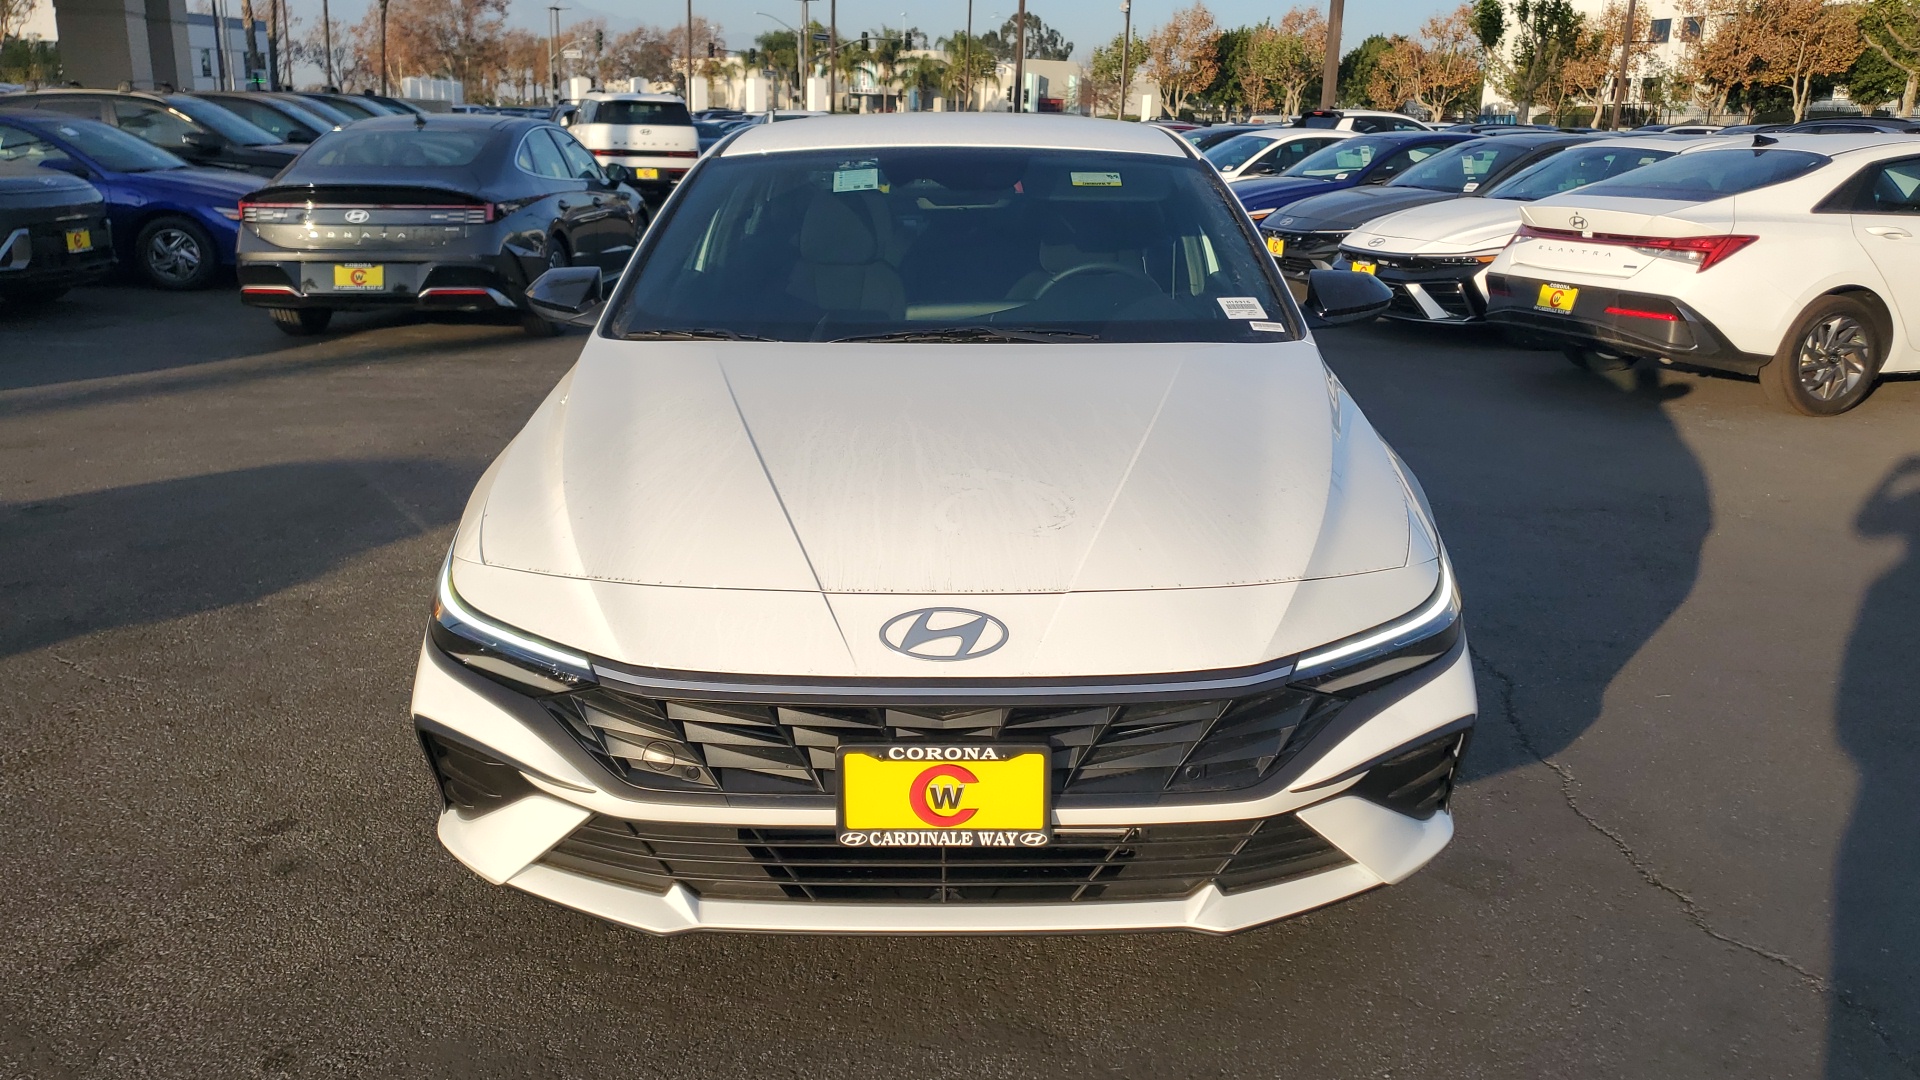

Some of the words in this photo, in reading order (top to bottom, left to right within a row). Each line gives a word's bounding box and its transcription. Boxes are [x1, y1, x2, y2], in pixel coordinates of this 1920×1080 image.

[1538, 245, 1612, 257] ELANTRA
[888, 747, 999, 760] CORONA
[869, 832, 973, 847] CARDINALE
[978, 832, 1019, 847] WAY
